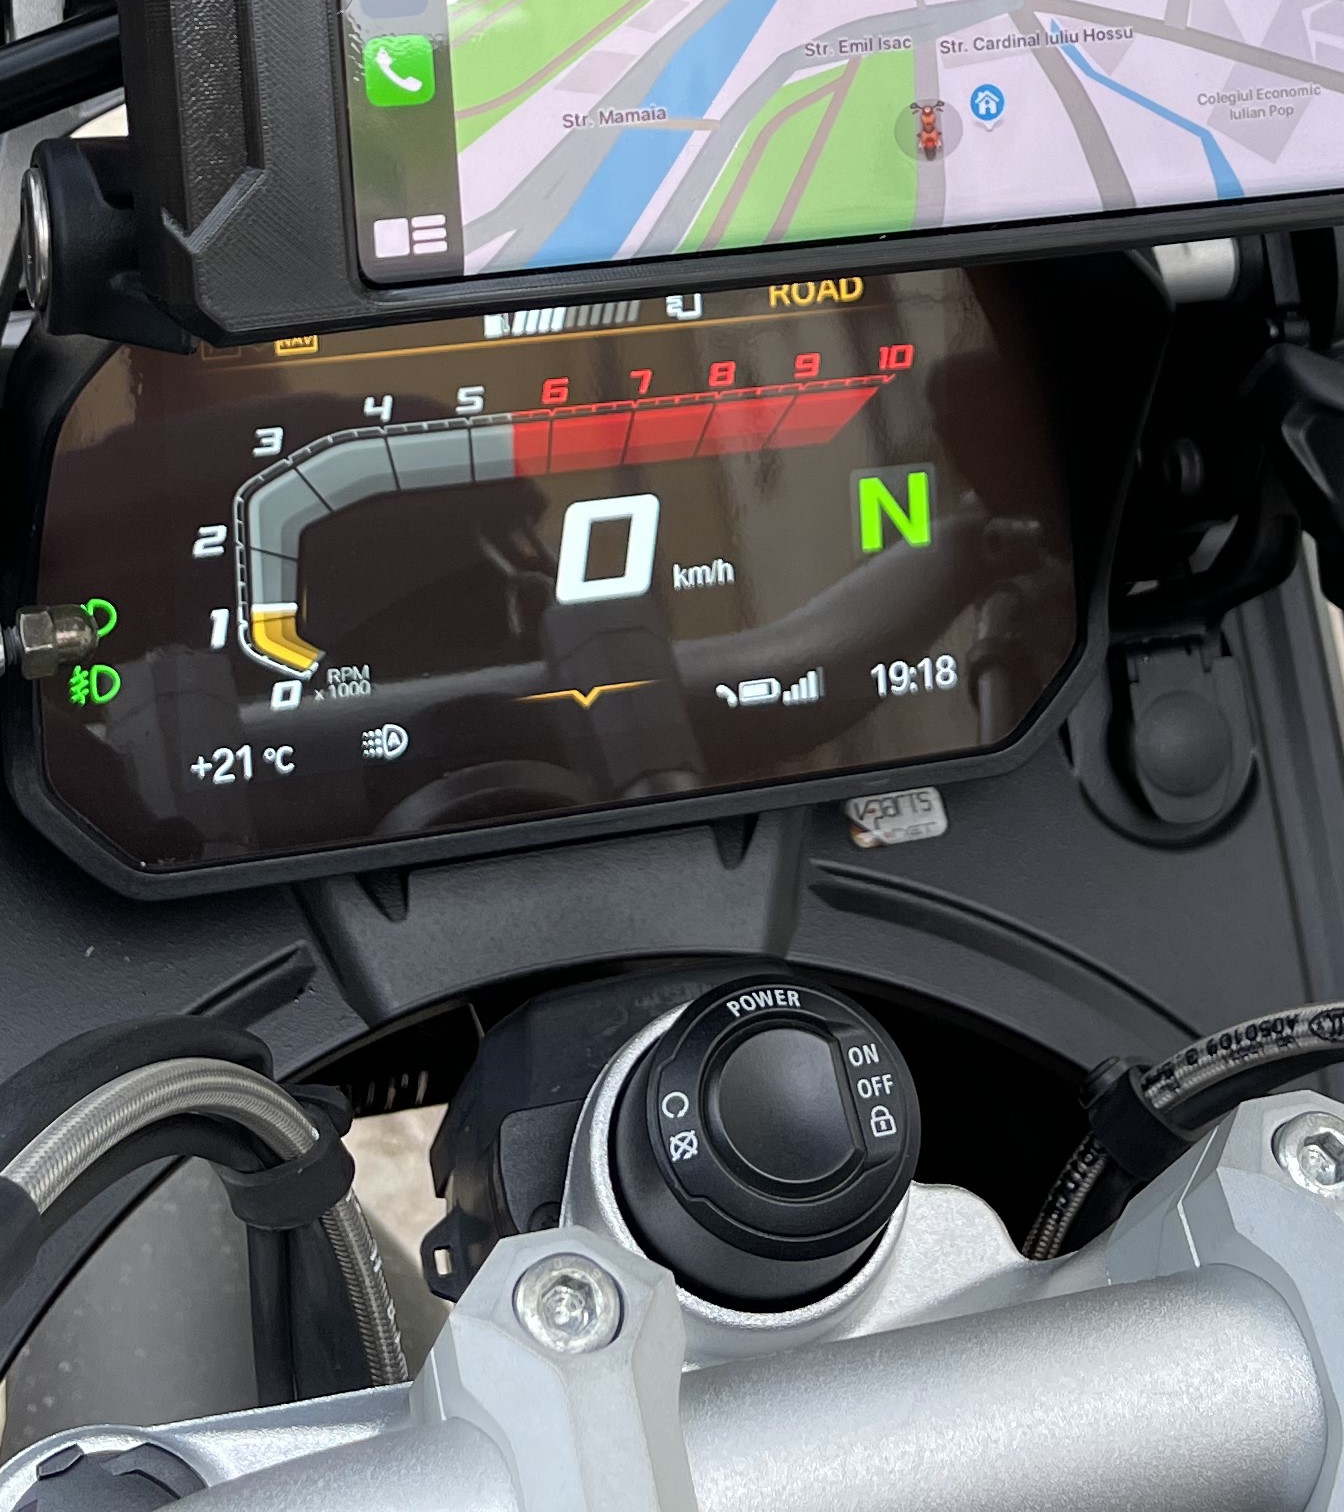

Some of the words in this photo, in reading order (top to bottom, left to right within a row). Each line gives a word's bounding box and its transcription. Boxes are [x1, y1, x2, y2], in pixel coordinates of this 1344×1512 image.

[804, 41, 835, 57] Str.
[838, 37, 874, 55] Emil
[877, 35, 912, 52] Isac
[939, 39, 969, 56] Str.
[973, 32, 1041, 53] Cardinal
[1044, 30, 1080, 47] Iuliu
[1083, 26, 1135, 44] Hossu
[1197, 89, 1254, 106] Colegiul
[1256, 83, 1322, 102] Economic
[562, 111, 594, 130] Str.
[599, 105, 668, 127] Mamaia
[1229, 106, 1267, 121] Iulian
[1269, 104, 1295, 119] Pop
[769, 276, 864, 309] ROAD
[794, 352, 822, 378] 9
[879, 344, 915, 371] 10
[629, 369, 653, 393] 7
[708, 361, 736, 386] 8
[456, 385, 485, 415] 5
[541, 377, 569, 405] 6
[363, 394, 394, 422] 4
[253, 427, 284, 456] 3
[859, 471, 931, 553] N
[192, 524, 228, 559] 2
[556, 493, 660, 605] 0
[672, 558, 736, 591] km/h
[210, 608, 230, 648] 1
[327, 664, 371, 684] RPM
[871, 654, 958, 698] 19:18
[270, 679, 303, 710] 0
[191, 744, 254, 785] +21
[726, 988, 801, 1018] POWER
[848, 1042, 881, 1066] ON
[857, 1073, 895, 1098] OFF
